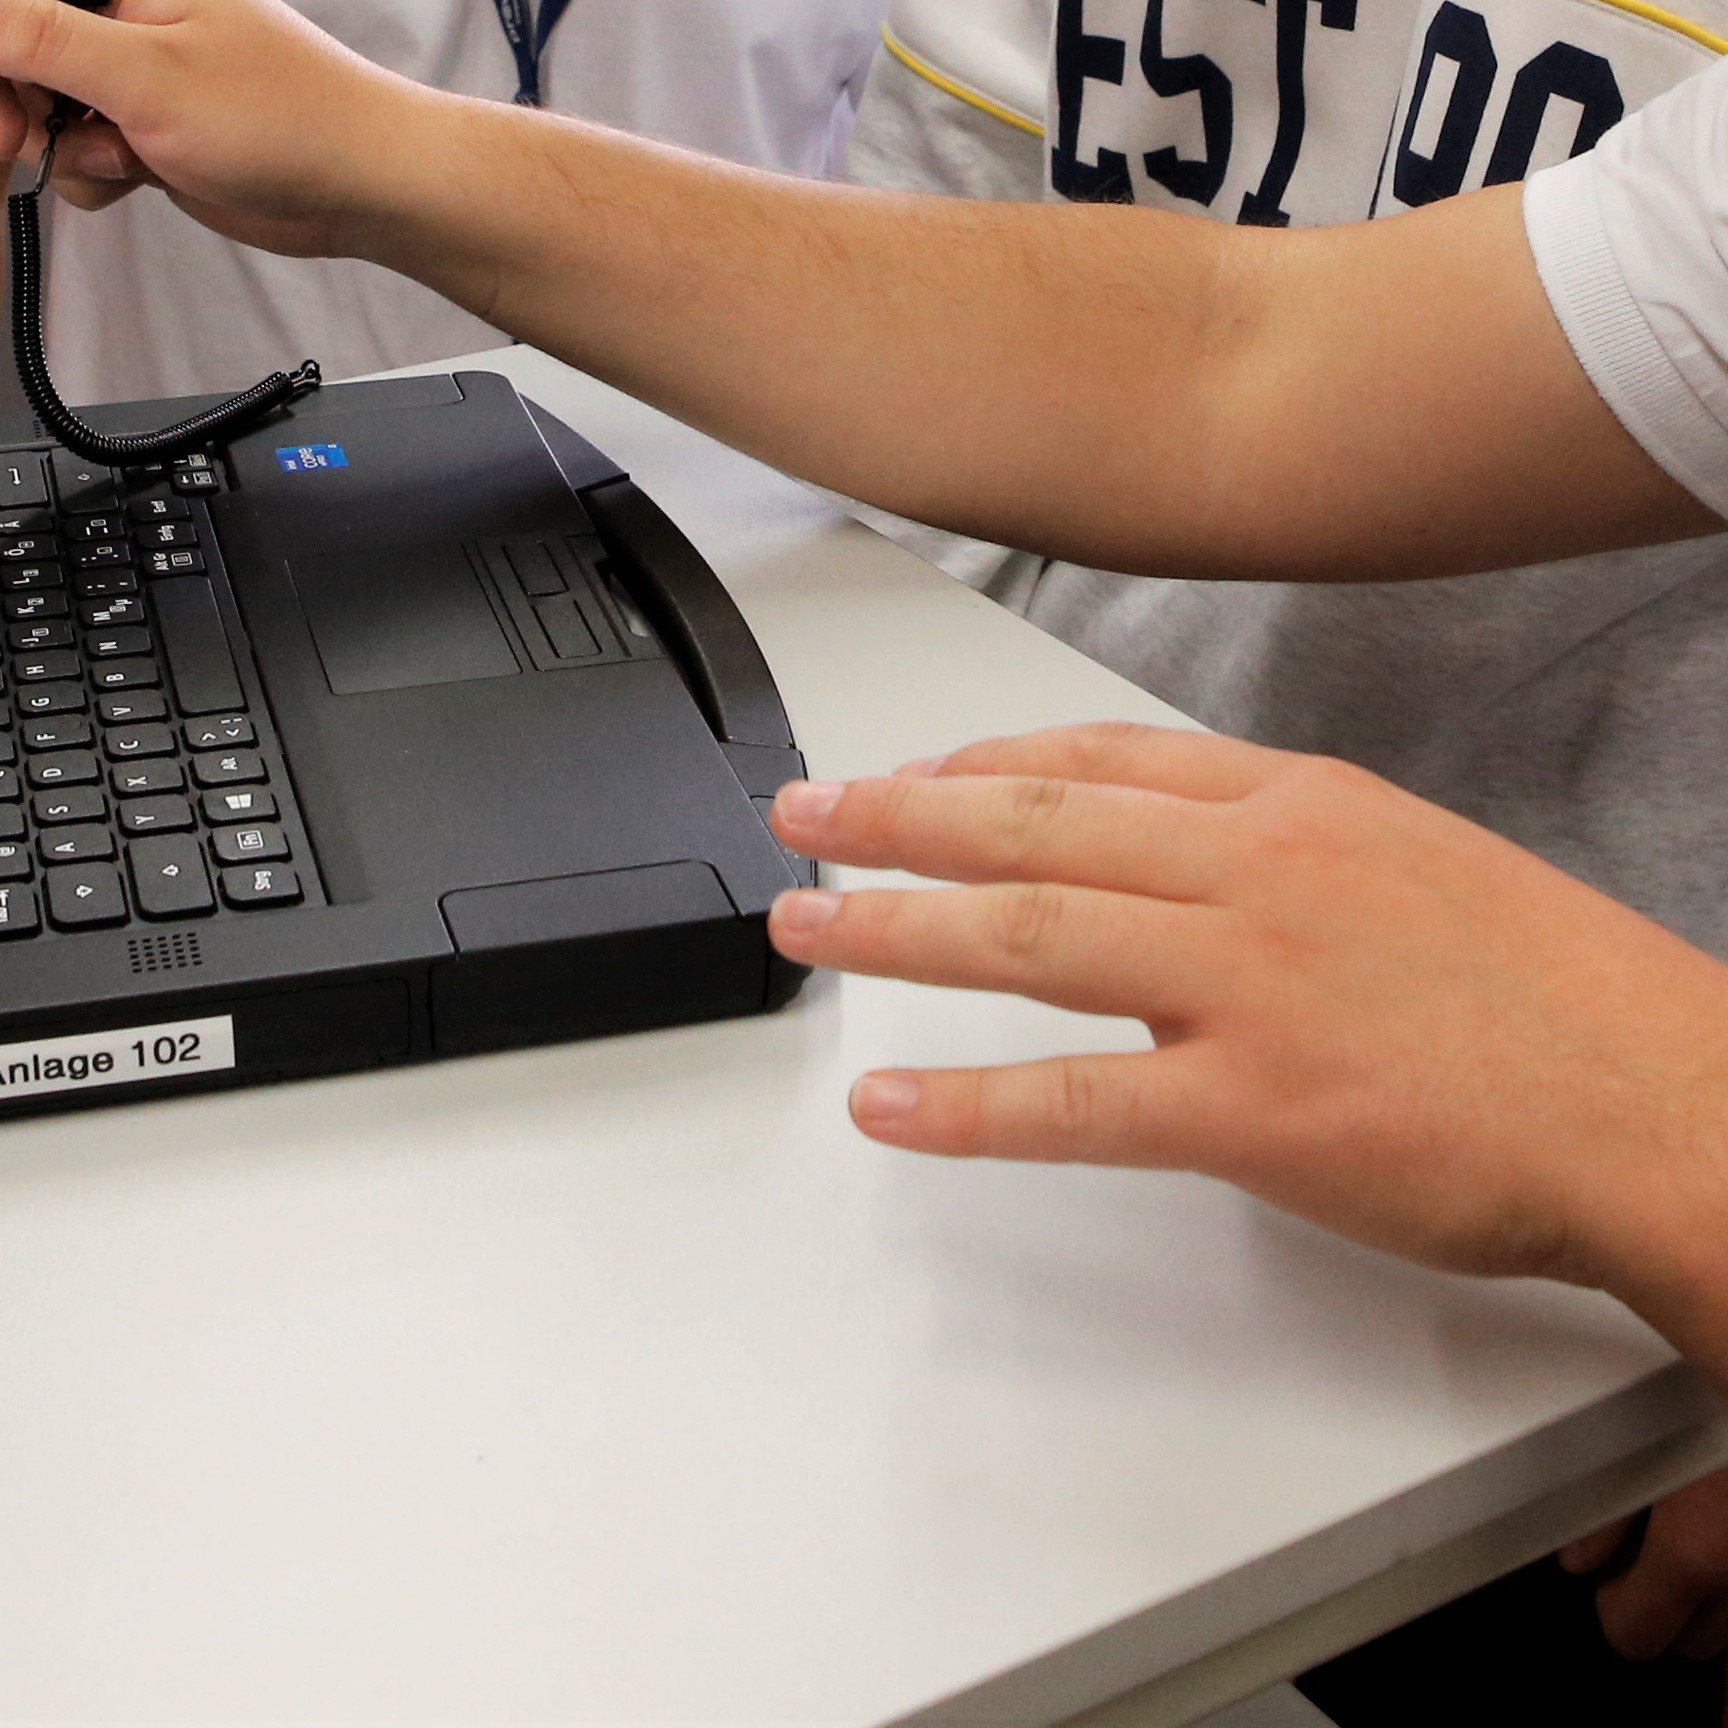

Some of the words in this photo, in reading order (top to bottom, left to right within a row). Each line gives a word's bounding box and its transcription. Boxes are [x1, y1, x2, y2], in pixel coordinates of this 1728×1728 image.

[93, 612, 110, 621] M
[99, 642, 117, 650] N
[26, 666, 44, 674] H
[32, 698, 49, 706] G
[221, 758, 237, 769] Alt
[43, 769, 61, 777] D
[128, 777, 146, 786] X
[135, 816, 154, 824] Y
[244, 832, 259, 847] Fn
[55, 842, 74, 852] A
[131, 1032, 201, 1067] 102
